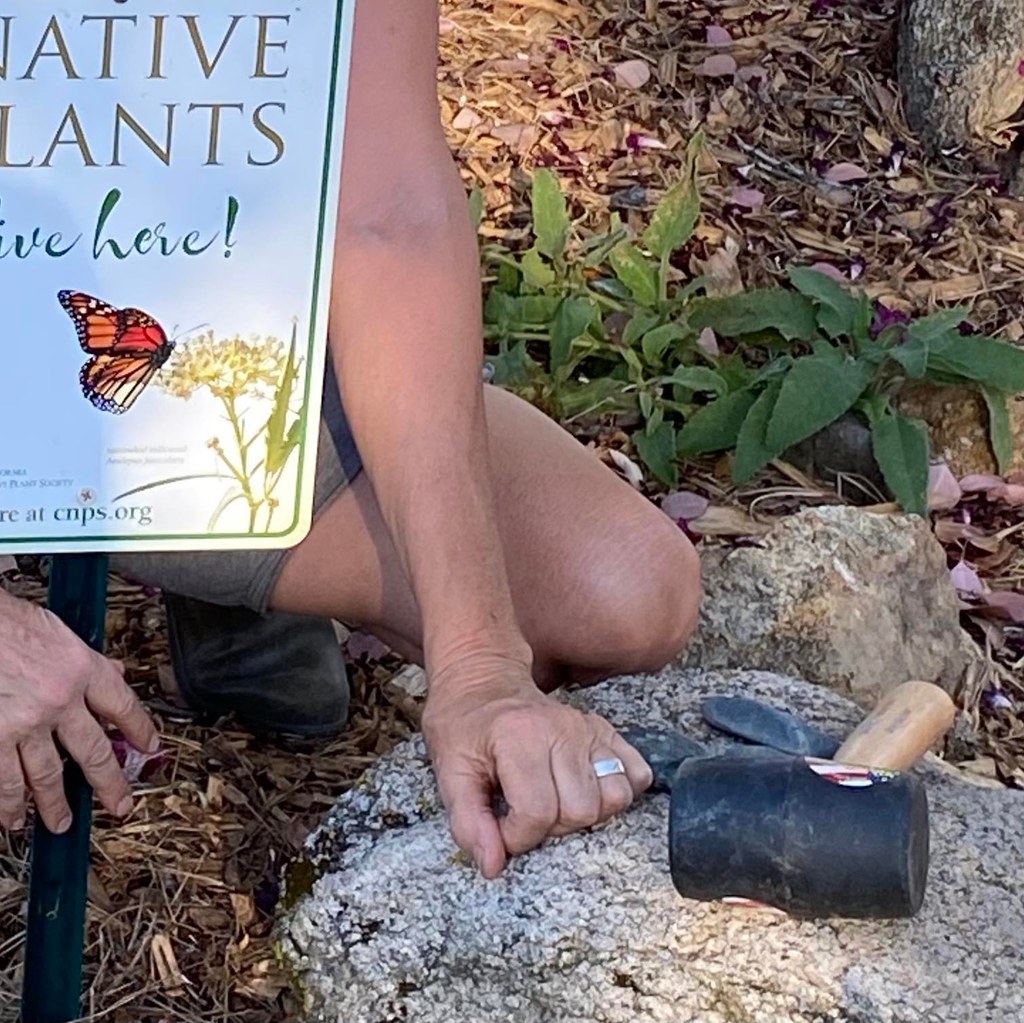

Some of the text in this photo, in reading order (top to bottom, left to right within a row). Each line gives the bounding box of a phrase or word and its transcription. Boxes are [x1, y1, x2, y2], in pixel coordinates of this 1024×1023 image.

[92, 188, 239, 259] here!
[25, 507, 44, 522] at
[53, 504, 153, 526] cnps.org
